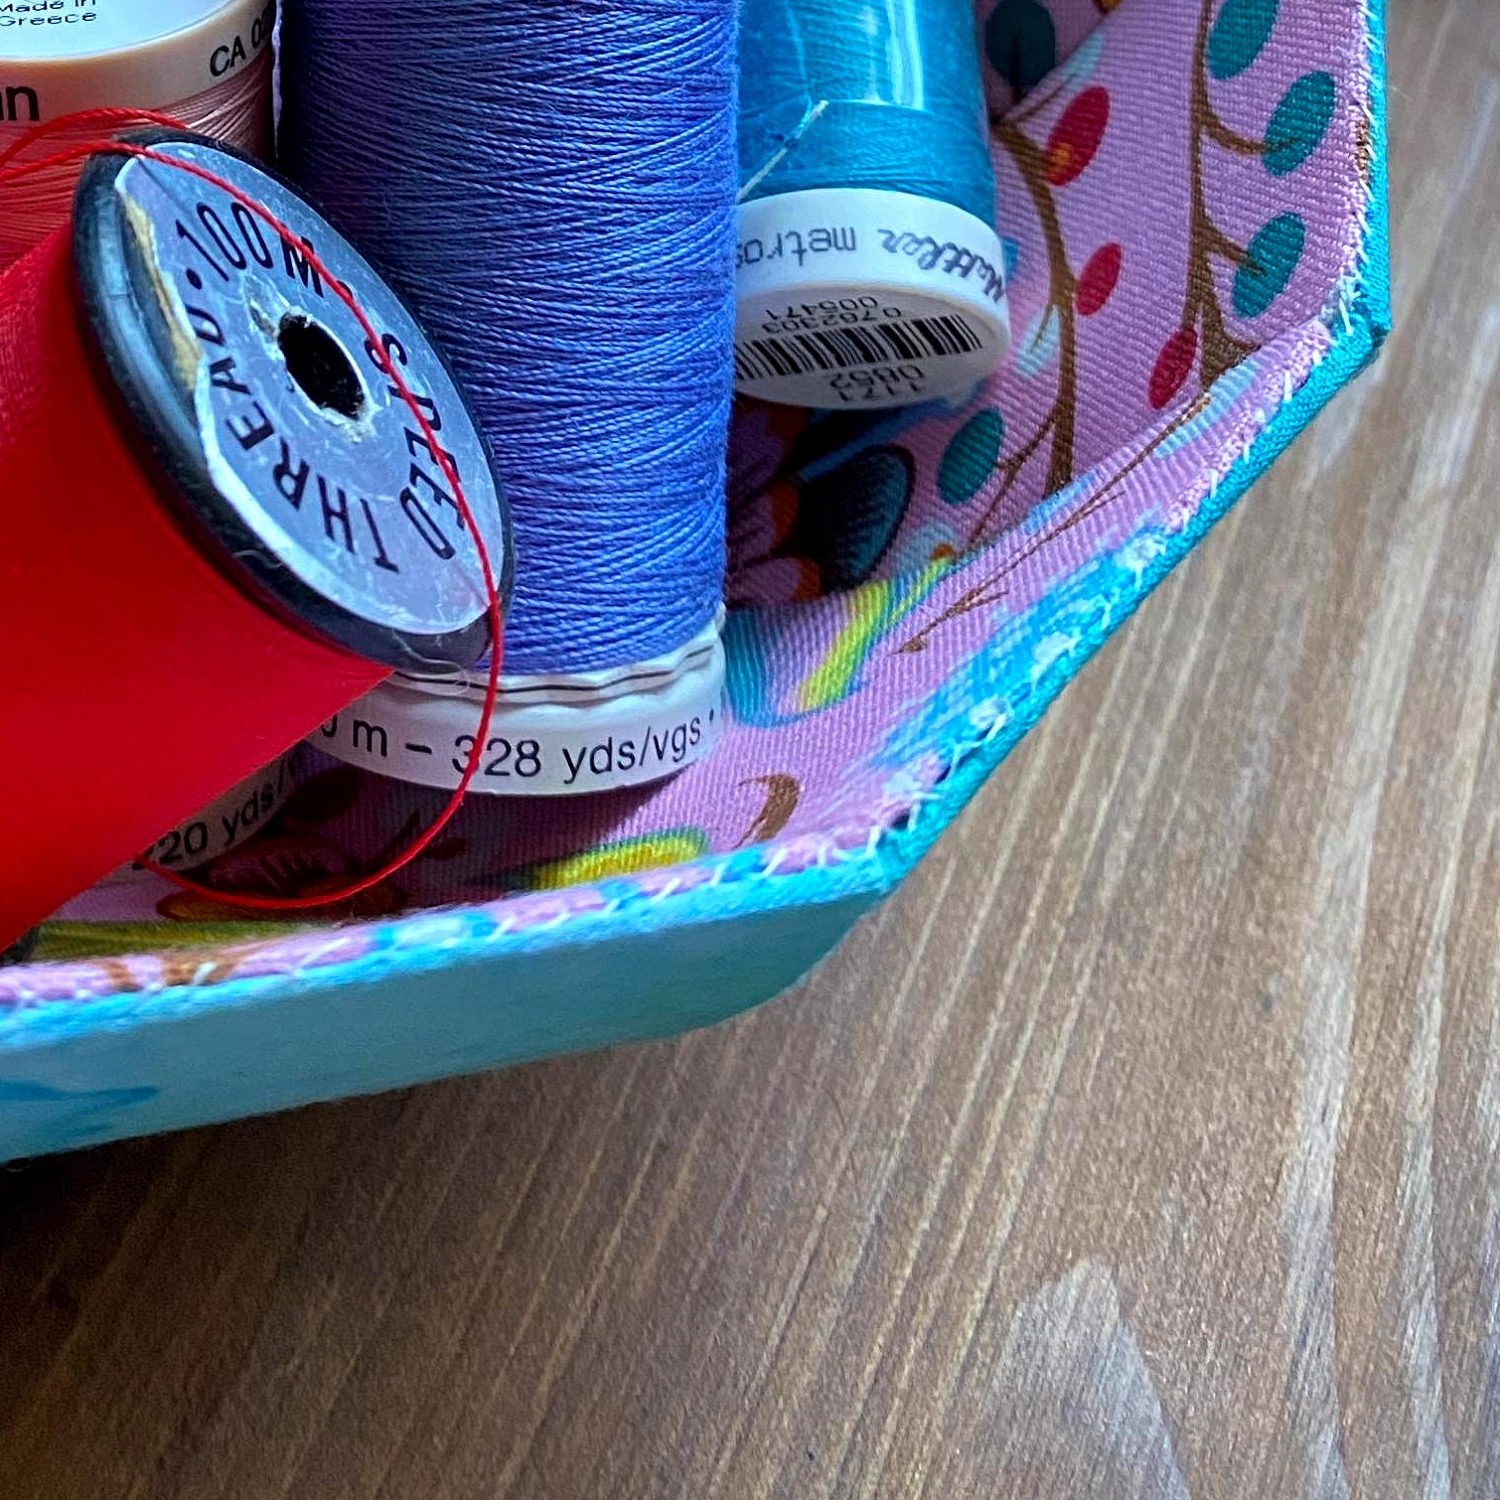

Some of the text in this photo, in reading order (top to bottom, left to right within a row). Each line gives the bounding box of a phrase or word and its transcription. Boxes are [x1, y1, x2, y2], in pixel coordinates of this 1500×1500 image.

[209, 35, 247, 77] CA
[186, 304, 400, 574] THREAD
[352, 719, 388, 757] m
[451, 733, 542, 778] 328
